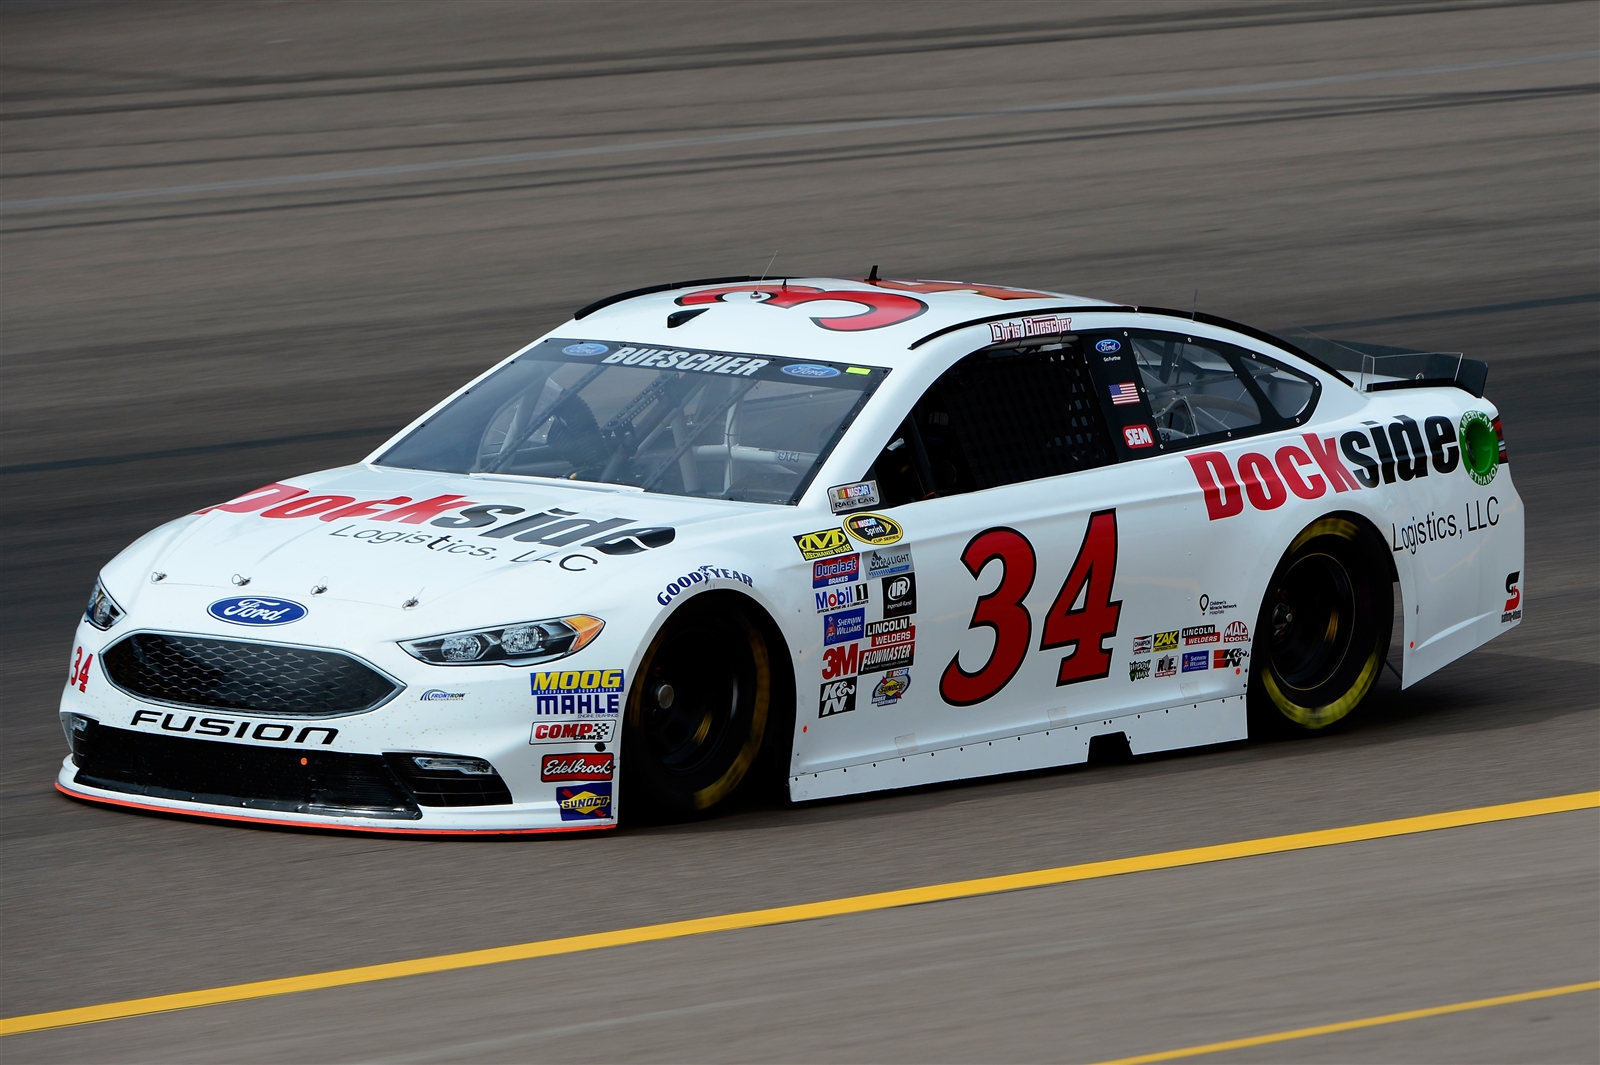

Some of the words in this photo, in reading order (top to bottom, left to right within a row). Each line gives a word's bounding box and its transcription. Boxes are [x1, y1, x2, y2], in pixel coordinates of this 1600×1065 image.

[988, 322, 1021, 342] Chris
[1022, 316, 1072, 338] Buescher
[601, 347, 769, 376] BUESCHER
[791, 367, 829, 377] Ford
[1460, 410, 1494, 436] AMERICAN
[1125, 427, 1152, 446] SEM
[1470, 463, 1499, 485] ETHANOL
[847, 484, 871, 498] NASCAR
[834, 499, 857, 509] RACE
[857, 496, 875, 504] CAR
[864, 525, 885, 537] Sprint
[1392, 510, 1463, 555] Logistics,
[1465, 496, 1500, 533] LLC
[328, 523, 498, 562] Logistics,
[509, 549, 598, 572] LLC
[803, 550, 835, 561] MECHANIX
[835, 545, 852, 554] WEAR
[815, 558, 857, 577] Duralast
[891, 553, 909, 565] LIGHT
[828, 575, 849, 585] BRAKES
[891, 580, 907, 597] IR
[815, 586, 853, 610] Mobil
[222, 597, 291, 622] Ford
[938, 507, 1123, 708] 34
[837, 616, 862, 627] SHERWIN
[867, 618, 908, 636] LINCOLN
[1224, 621, 1248, 636] MAC
[875, 631, 911, 645] WELDERS
[1154, 631, 1178, 647] ZAK
[1183, 626, 1214, 637] LINCOLN
[1188, 635, 1218, 644] WELDERS
[822, 643, 859, 680] 3M
[861, 644, 911, 672] FLOWMASTER
[70, 645, 93, 693] 34
[533, 670, 622, 691] MOOG
[536, 694, 620, 716] MAHLE
[130, 709, 340, 745] FUSION
[535, 723, 594, 739] COMP
[543, 758, 612, 775] Edelbrock
[563, 796, 610, 810] SUNOCO
